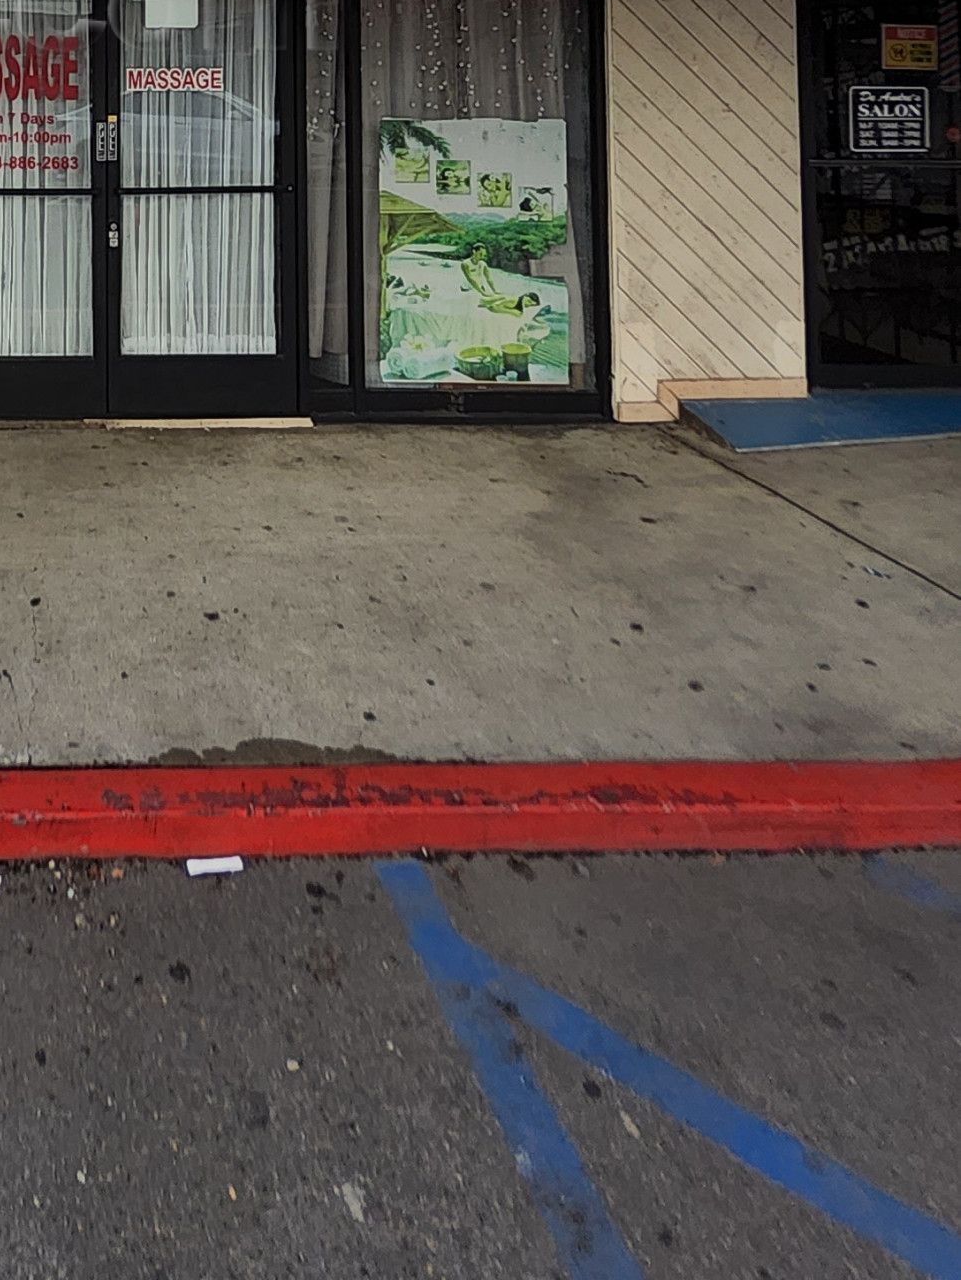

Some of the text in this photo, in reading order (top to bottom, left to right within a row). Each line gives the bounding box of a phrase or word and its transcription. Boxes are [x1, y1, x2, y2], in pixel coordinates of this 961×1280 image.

[127, 69, 222, 90] MASSAGE
[857, 103, 923, 118] SALON
[8, 113, 16, 125] 7
[20, 113, 55, 127] Days
